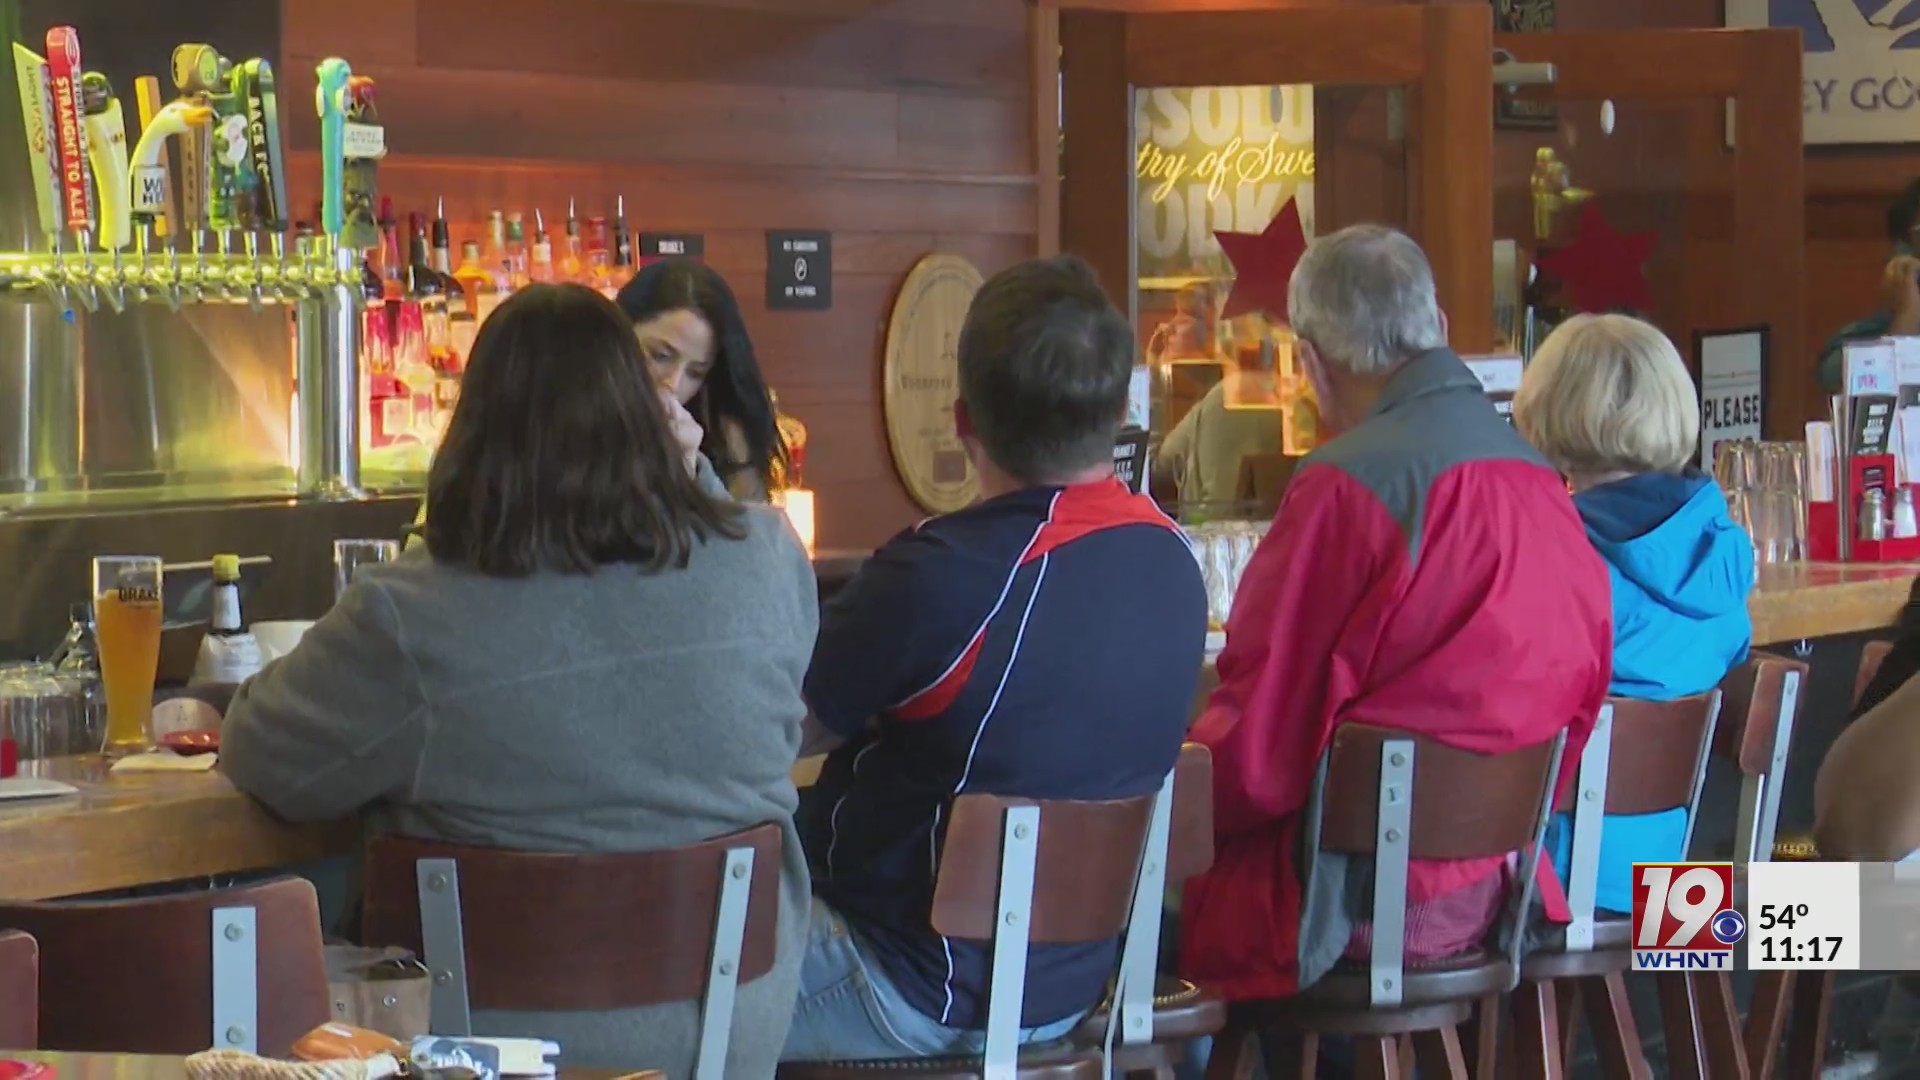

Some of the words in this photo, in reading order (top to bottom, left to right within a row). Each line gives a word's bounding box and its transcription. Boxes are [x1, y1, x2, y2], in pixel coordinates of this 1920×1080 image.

[1850, 76, 1920, 111] GO
[55, 76, 81, 156] STRAIGHT
[67, 158, 81, 183] TO
[1191, 136, 1241, 202] of
[70, 186, 87, 219] ALE
[1704, 394, 1760, 430] PLEASE
